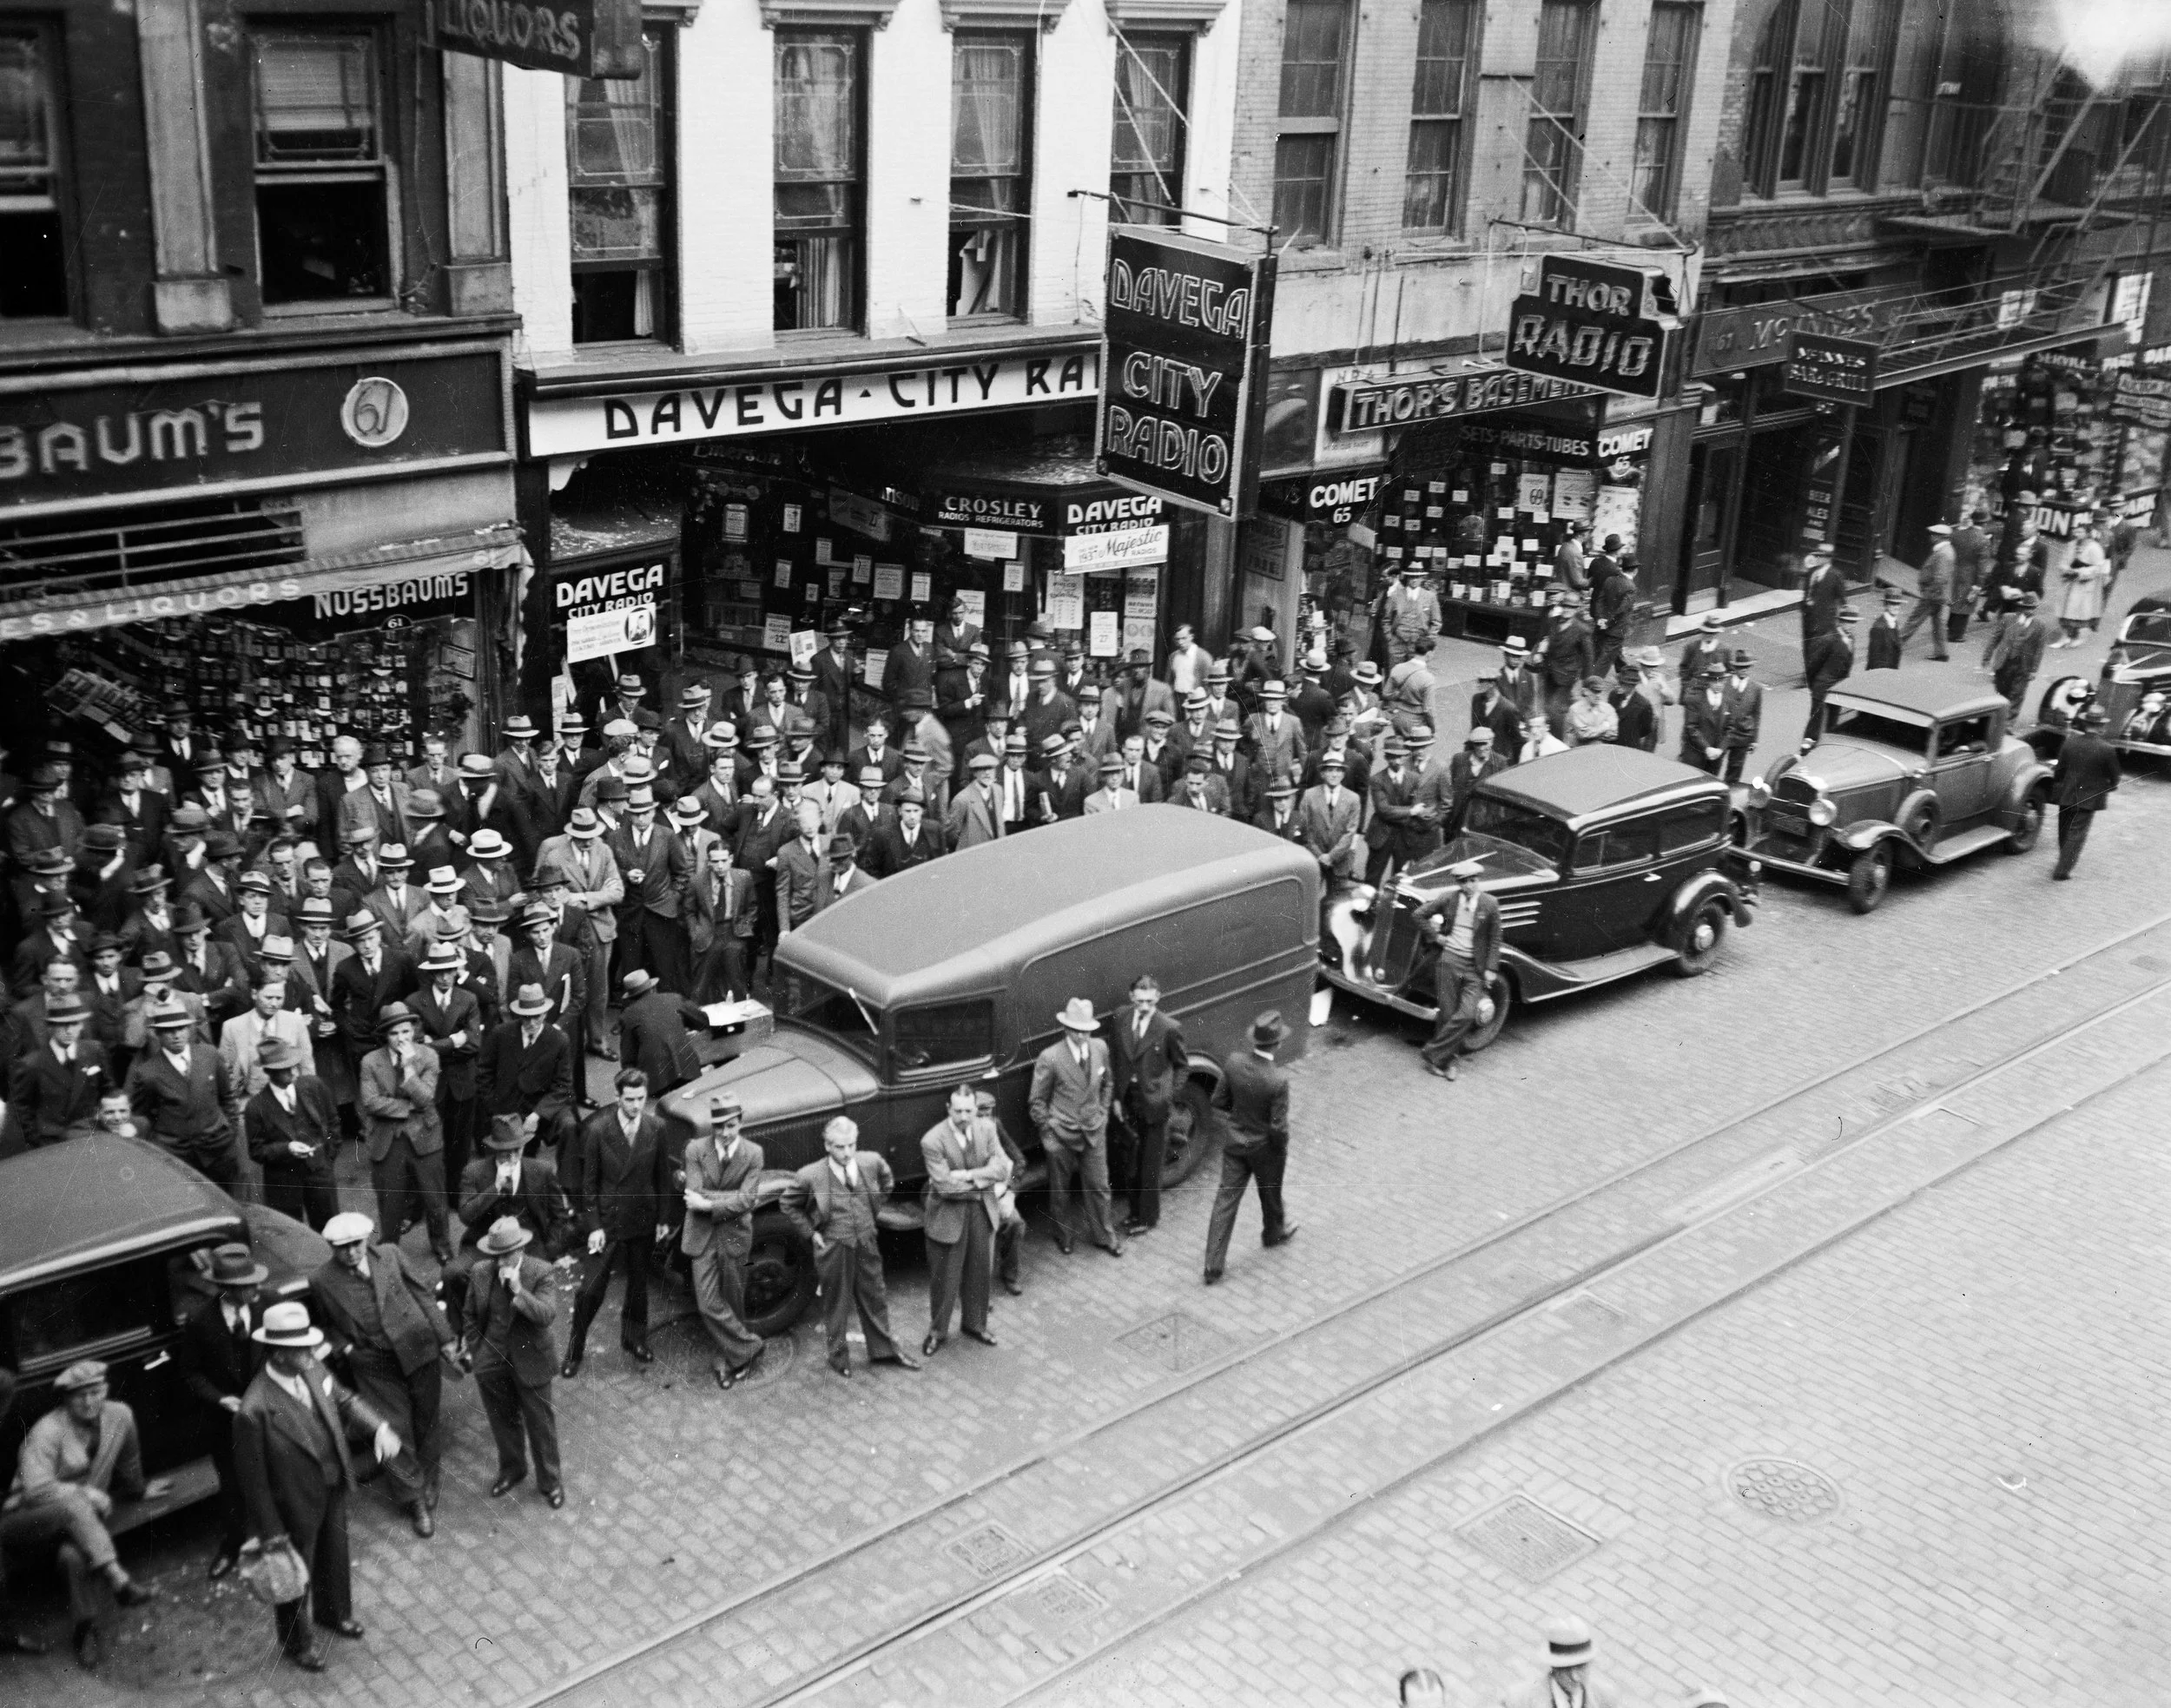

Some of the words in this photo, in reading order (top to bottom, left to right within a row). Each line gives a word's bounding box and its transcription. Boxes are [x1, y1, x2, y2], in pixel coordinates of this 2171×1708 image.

[1109, 259, 1250, 340] DAVEGA
[1547, 274, 1633, 316] THOR
[1513, 313, 1654, 378] RADIO
[604, 379, 842, 440] DAVEGA
[887, 363, 1000, 409] CITY
[1123, 351, 1222, 419] CITY
[1354, 380, 1457, 425] THOR'S
[353, 383, 395, 436] 61
[1107, 405, 1230, 485] RADIO
[1598, 428, 1653, 458] COMET
[945, 496, 1041, 518] CROSLEY
[1067, 496, 1163, 524] DAVEGA
[1310, 477, 1379, 508] COMET
[938, 511, 970, 521] RADIOS
[975, 515, 1044, 528] REFRIGERATORS
[1076, 523, 1107, 536] CITY
[1109, 517, 1155, 531] RADIO
[1333, 506, 1352, 523] 65
[1105, 528, 1163, 557] Majestic
[1131, 547, 1158, 557] RADIOS
[105, 577, 301, 621] LIQUORS
[313, 572, 469, 619] NUSSBAUMS
[557, 564, 663, 608] DAVEGA
[387, 617, 403, 629] 61
[568, 602, 602, 619] CITY
[605, 591, 654, 612] RADIO
